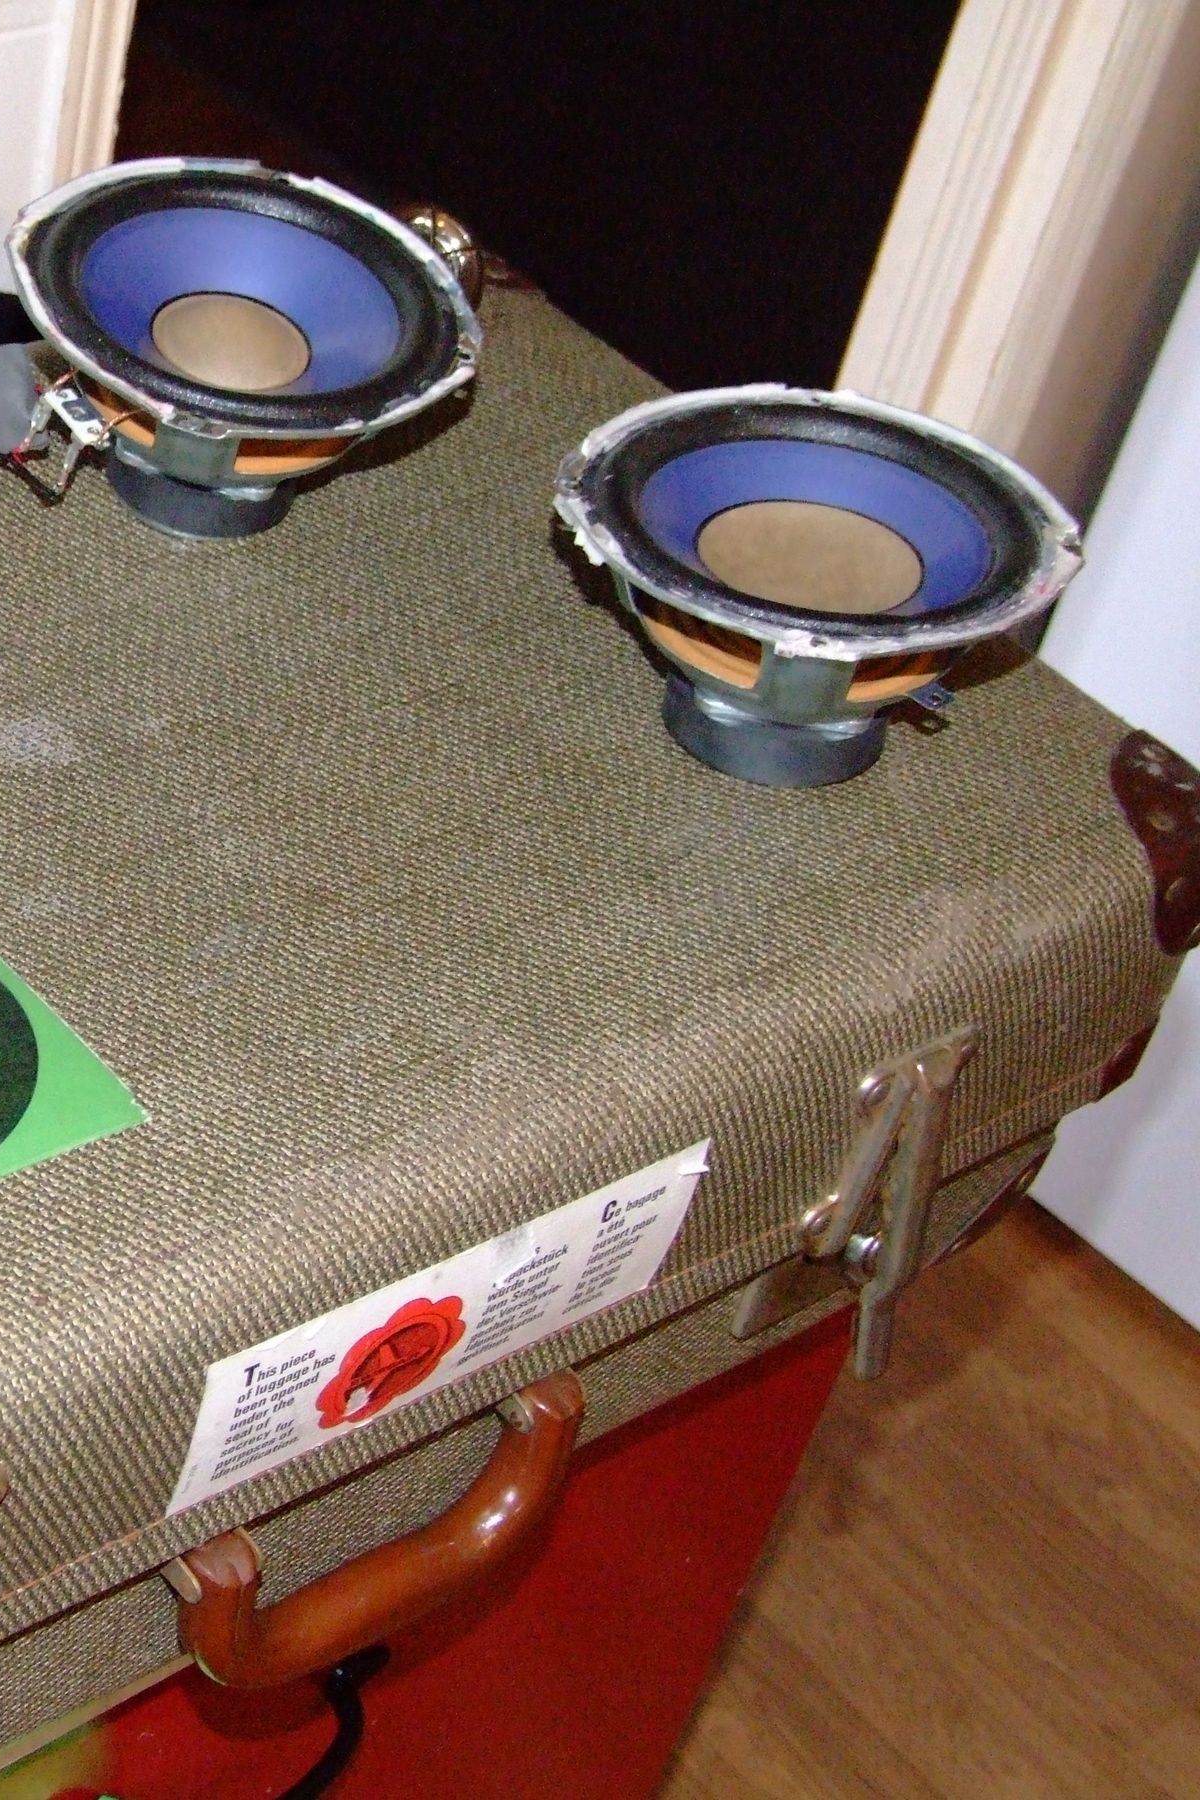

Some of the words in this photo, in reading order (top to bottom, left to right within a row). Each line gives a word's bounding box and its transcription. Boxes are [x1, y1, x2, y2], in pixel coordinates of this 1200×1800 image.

[601, 1200, 621, 1223] Ce
[626, 1186, 667, 1212] bagage
[592, 1227, 631, 1252] ouvert
[630, 1214, 658, 1236] pour
[237, 1388, 253, 1404] of
[255, 1368, 309, 1397] luggage
[312, 1354, 336, 1371] has
[244, 1363, 278, 1388] This
[280, 1349, 316, 1375] piece
[229, 1407, 270, 1432] under
[272, 1397, 295, 1413] the
[234, 1397, 267, 1419] been
[270, 1372, 320, 1407] opened
[219, 1428, 270, 1458] secrecy
[275, 1419, 295, 1434] for
[224, 1426, 254, 1446] seal
[256, 1417, 270, 1433] of
[214, 1437, 276, 1472] purposes
